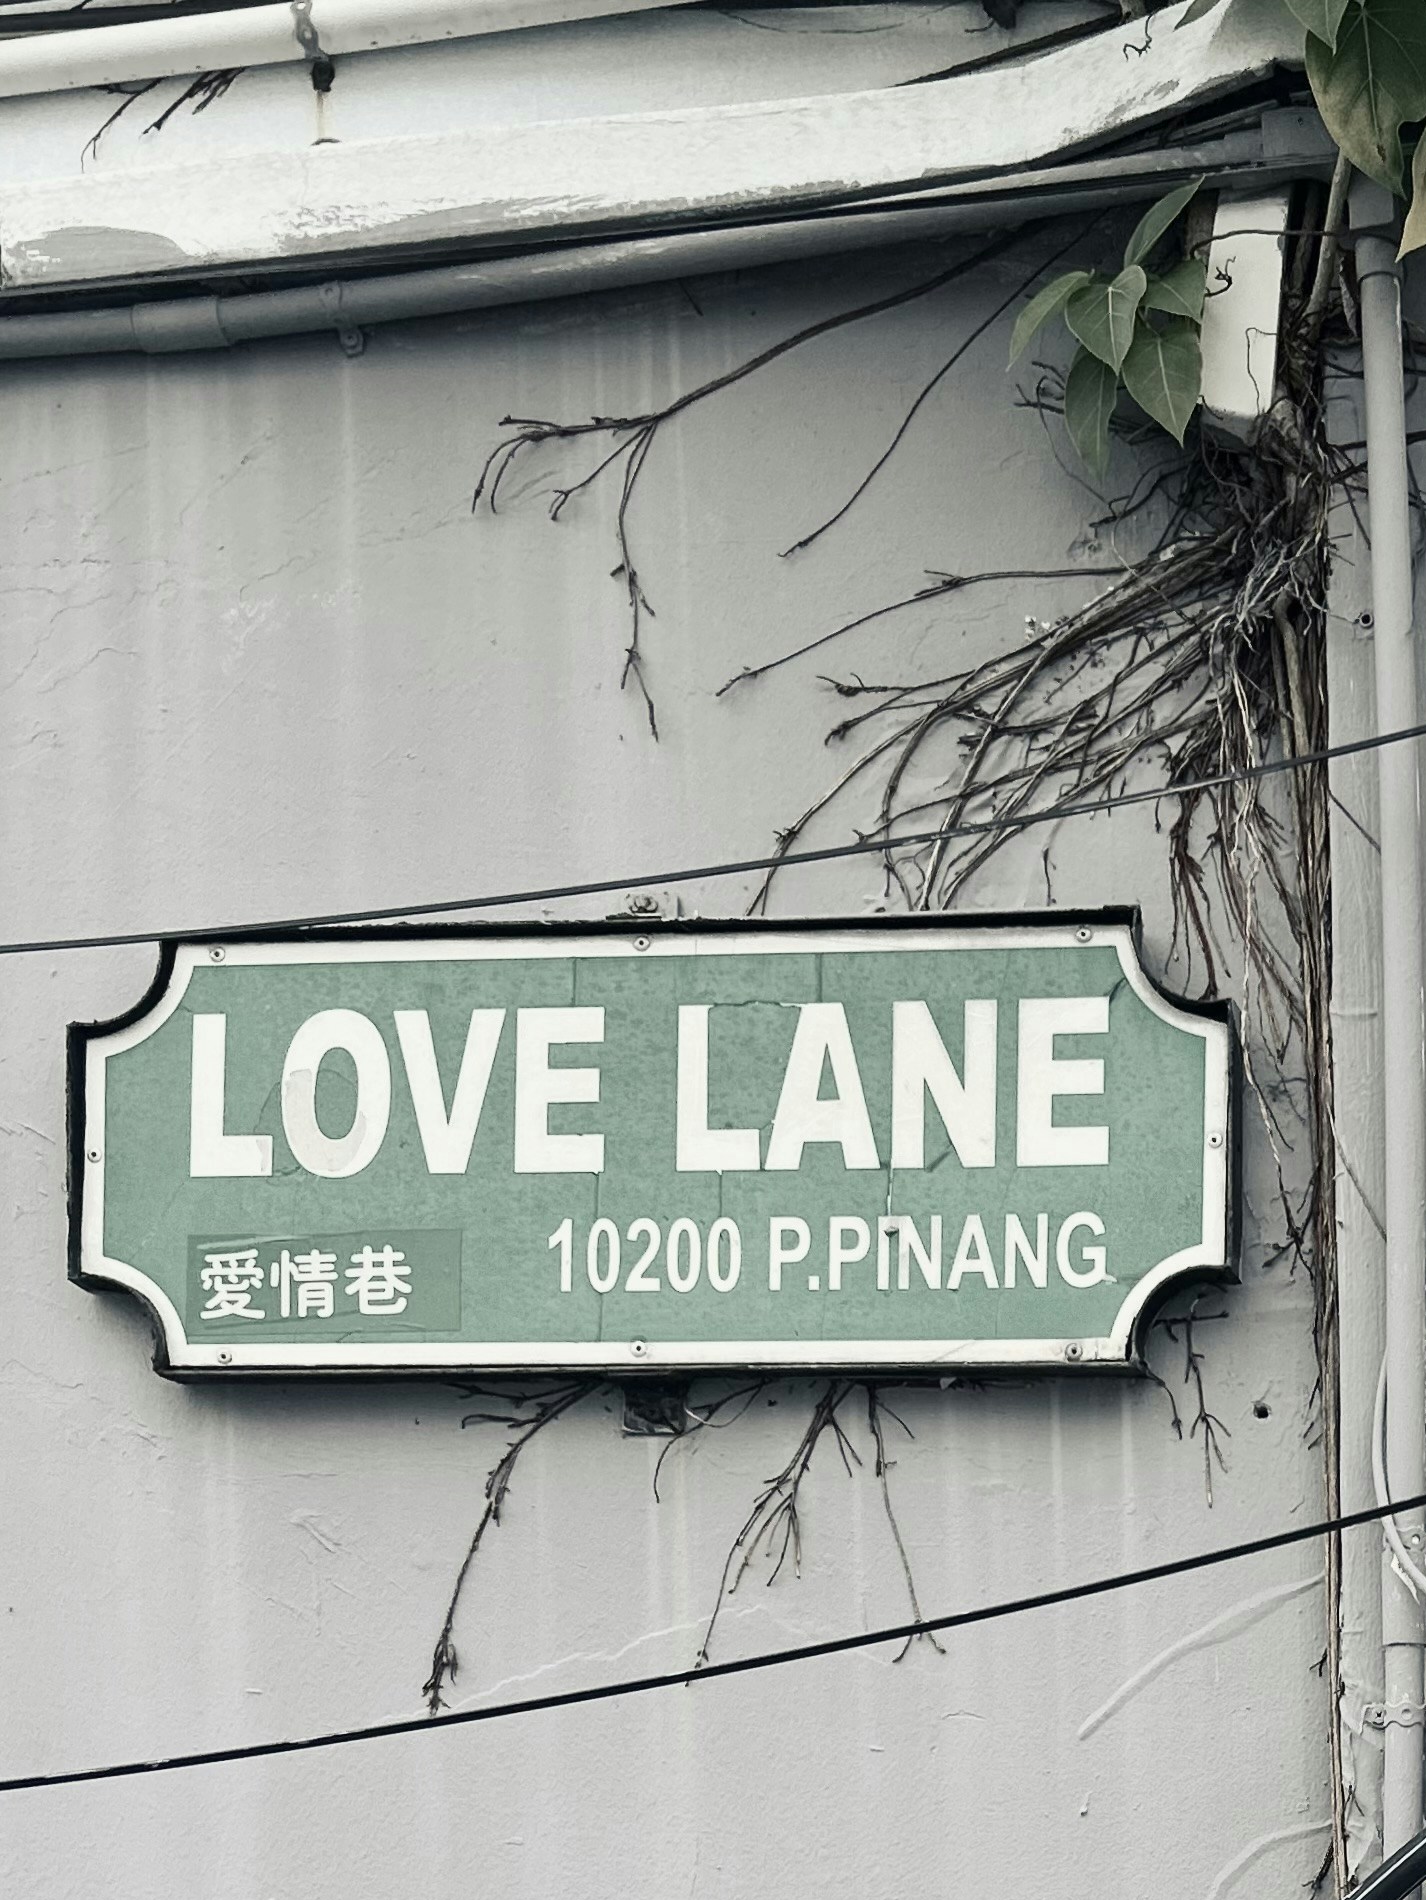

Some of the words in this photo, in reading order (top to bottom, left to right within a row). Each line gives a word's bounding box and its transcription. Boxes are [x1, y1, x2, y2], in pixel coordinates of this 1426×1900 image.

[189, 1007, 606, 1179] LOVE
[676, 996, 1110, 1173] LANE
[200, 1244, 414, 1320] 愛情巷
[547, 1217, 743, 1295] 10200
[768, 1212, 1116, 1291] P.PINANG
